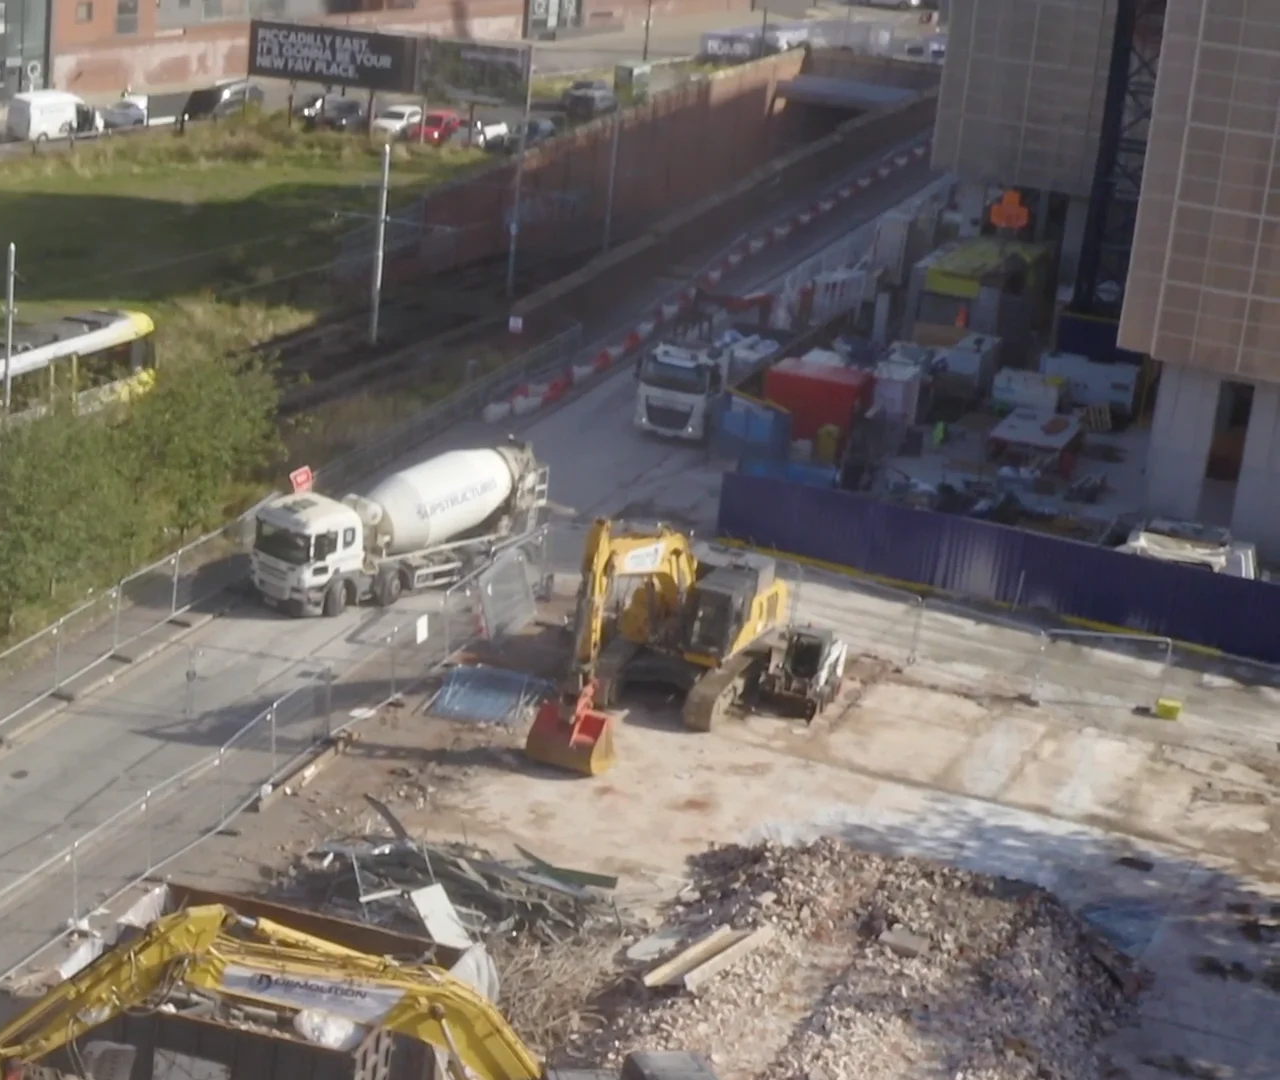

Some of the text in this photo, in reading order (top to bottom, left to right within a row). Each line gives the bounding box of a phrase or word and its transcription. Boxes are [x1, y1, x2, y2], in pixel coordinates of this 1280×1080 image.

[257, 28, 333, 45] PICCADILLY
[257, 42, 393, 68] IT'S GONNA BE YOUR
[255, 55, 359, 79] NEW FAV PLACE.
[274, 977, 368, 1000] DEMOLITION
